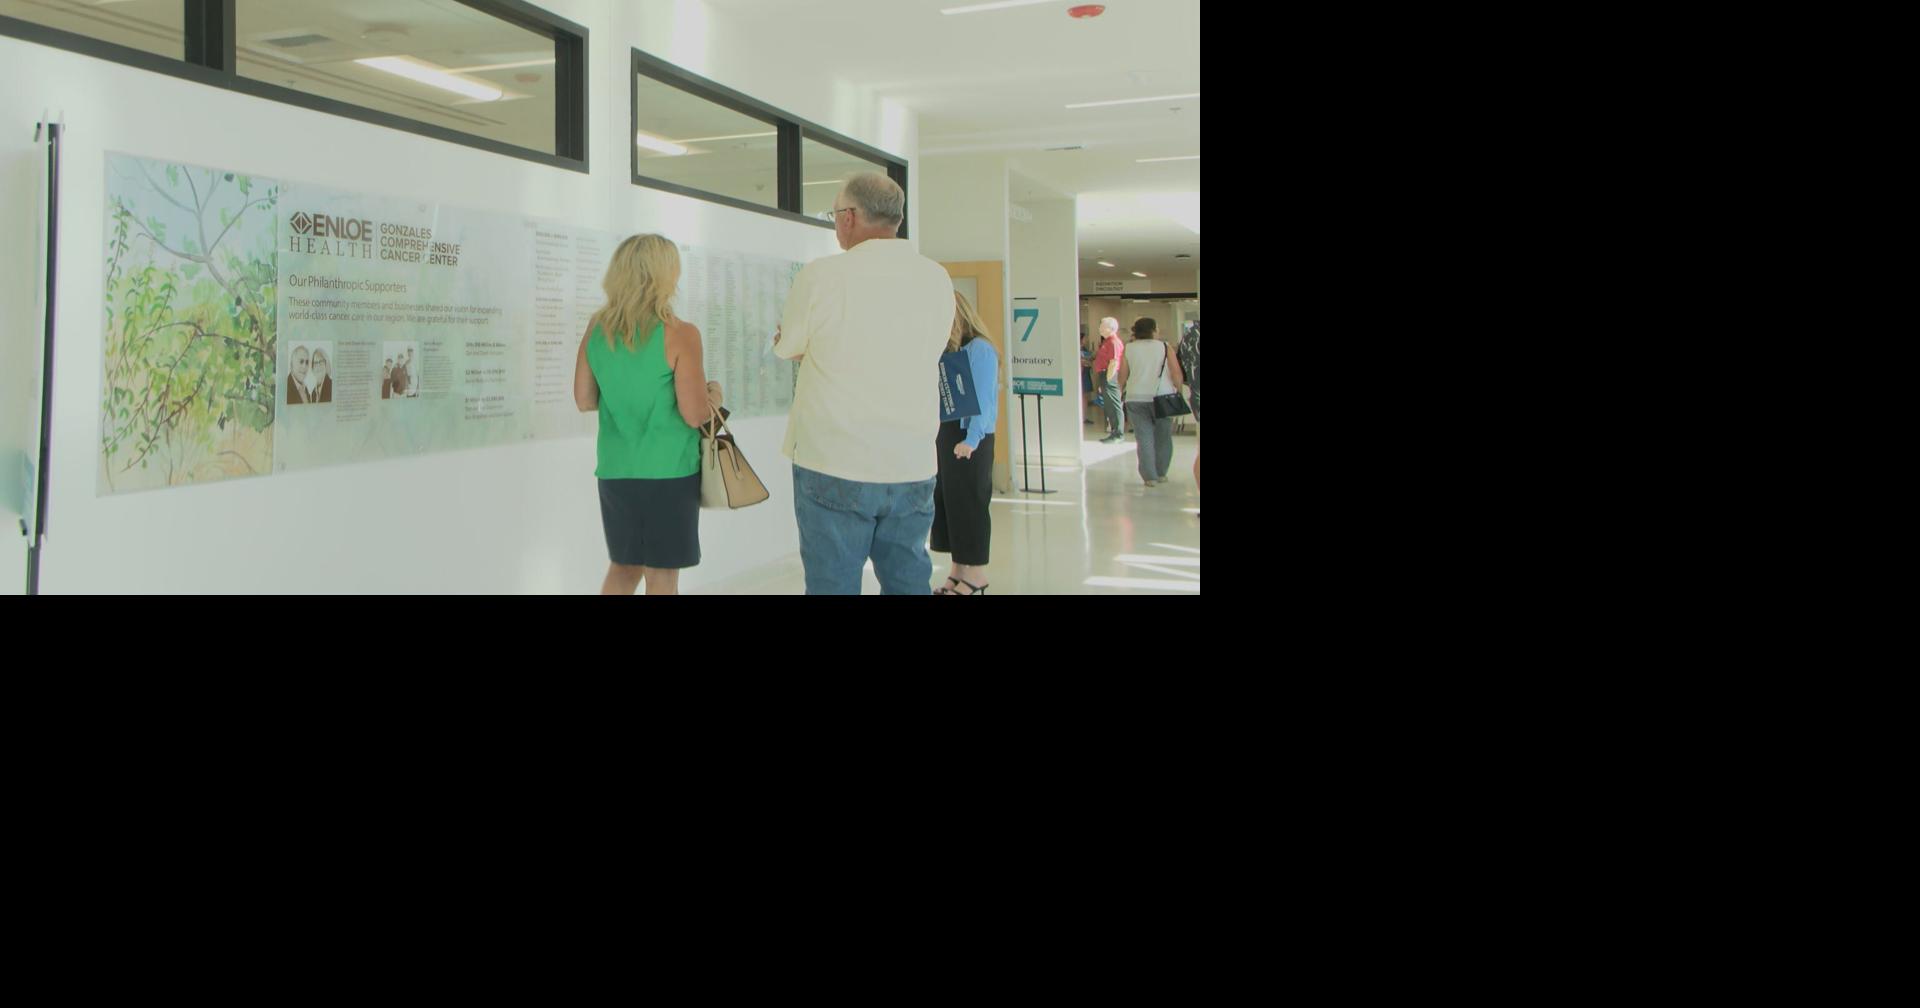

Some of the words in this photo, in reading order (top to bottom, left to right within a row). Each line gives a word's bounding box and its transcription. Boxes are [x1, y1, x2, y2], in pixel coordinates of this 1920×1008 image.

[313, 213, 372, 242] ENLOE
[380, 223, 432, 239] GONZALES
[290, 236, 372, 259] HEALTH
[380, 236, 461, 255] COMPREHENSIVE
[380, 249, 421, 263] CANCER
[289, 274, 307, 287] Our
[308, 276, 365, 291] Philanthropic
[365, 280, 407, 294] Supporters
[288, 296, 311, 307] These
[312, 298, 349, 310] community
[288, 309, 327, 320] world-class
[329, 312, 350, 321] cancer
[1013, 308, 1039, 342] 7
[1012, 354, 1053, 366] boratory
